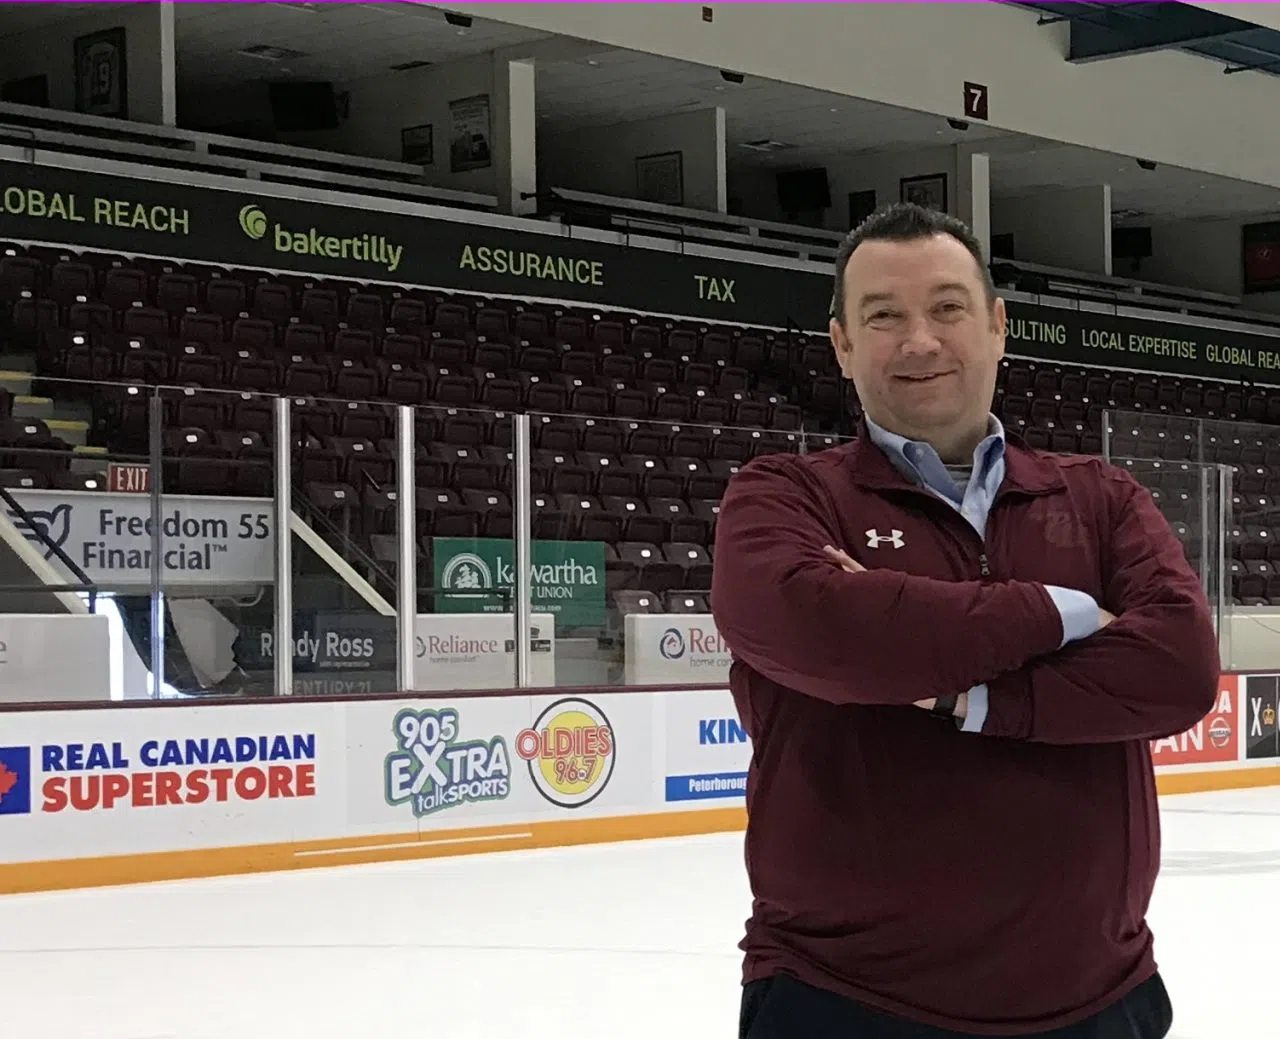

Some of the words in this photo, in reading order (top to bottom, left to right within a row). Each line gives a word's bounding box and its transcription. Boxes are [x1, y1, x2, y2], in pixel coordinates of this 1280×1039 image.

[970, 88, 981, 112] 7
[0, 187, 85, 222] OBAL
[94, 197, 189, 235] REACH
[274, 223, 402, 272] bakertilly
[459, 244, 603, 286] ASSURANCE
[694, 274, 736, 303] TAX
[1082, 329, 1125, 351] LOCAL
[1129, 334, 1197, 359] EXPERTISE
[1206, 344, 1255, 367] GLOBAL
[117, 467, 148, 491] EXIT
[238, 513, 269, 539] 55
[537, 586, 573, 599] UNION
[261, 631, 320, 662] Rdy
[326, 632, 374, 657] Ross
[428, 636, 498, 654] Reliance
[293, 680, 353, 694] ENTURY
[400, 715, 456, 748] 905
[1251, 697, 1262, 737] X
[41, 743, 129, 771] REAL
[140, 734, 315, 767] CANADIAN
[515, 725, 612, 760] OLDIES
[1150, 720, 1203, 754] AN
[391, 741, 508, 800] EXTRA
[41, 764, 316, 813] SUPERSTORE
